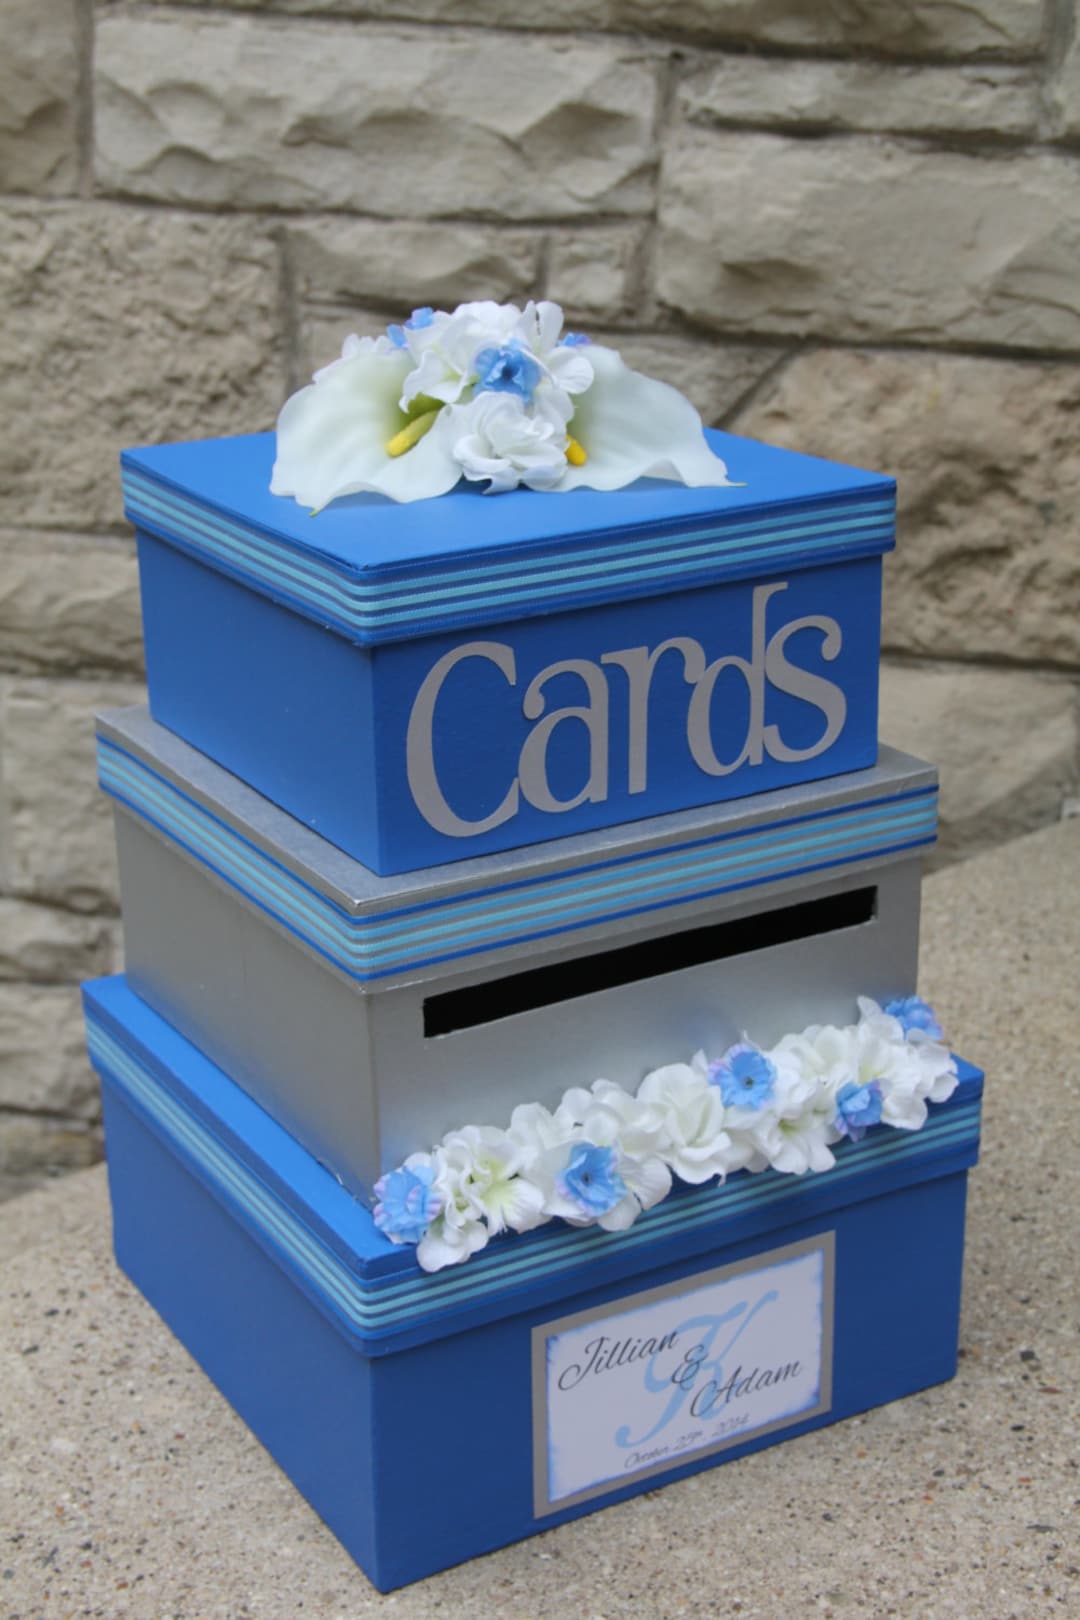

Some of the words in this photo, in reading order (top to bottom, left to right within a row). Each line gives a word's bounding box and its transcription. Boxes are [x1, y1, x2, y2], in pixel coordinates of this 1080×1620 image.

[406, 582, 847, 838] Cards
[557, 1331, 679, 1391] Jillian
[671, 1344, 706, 1391] &
[689, 1361, 801, 1418] Adam
